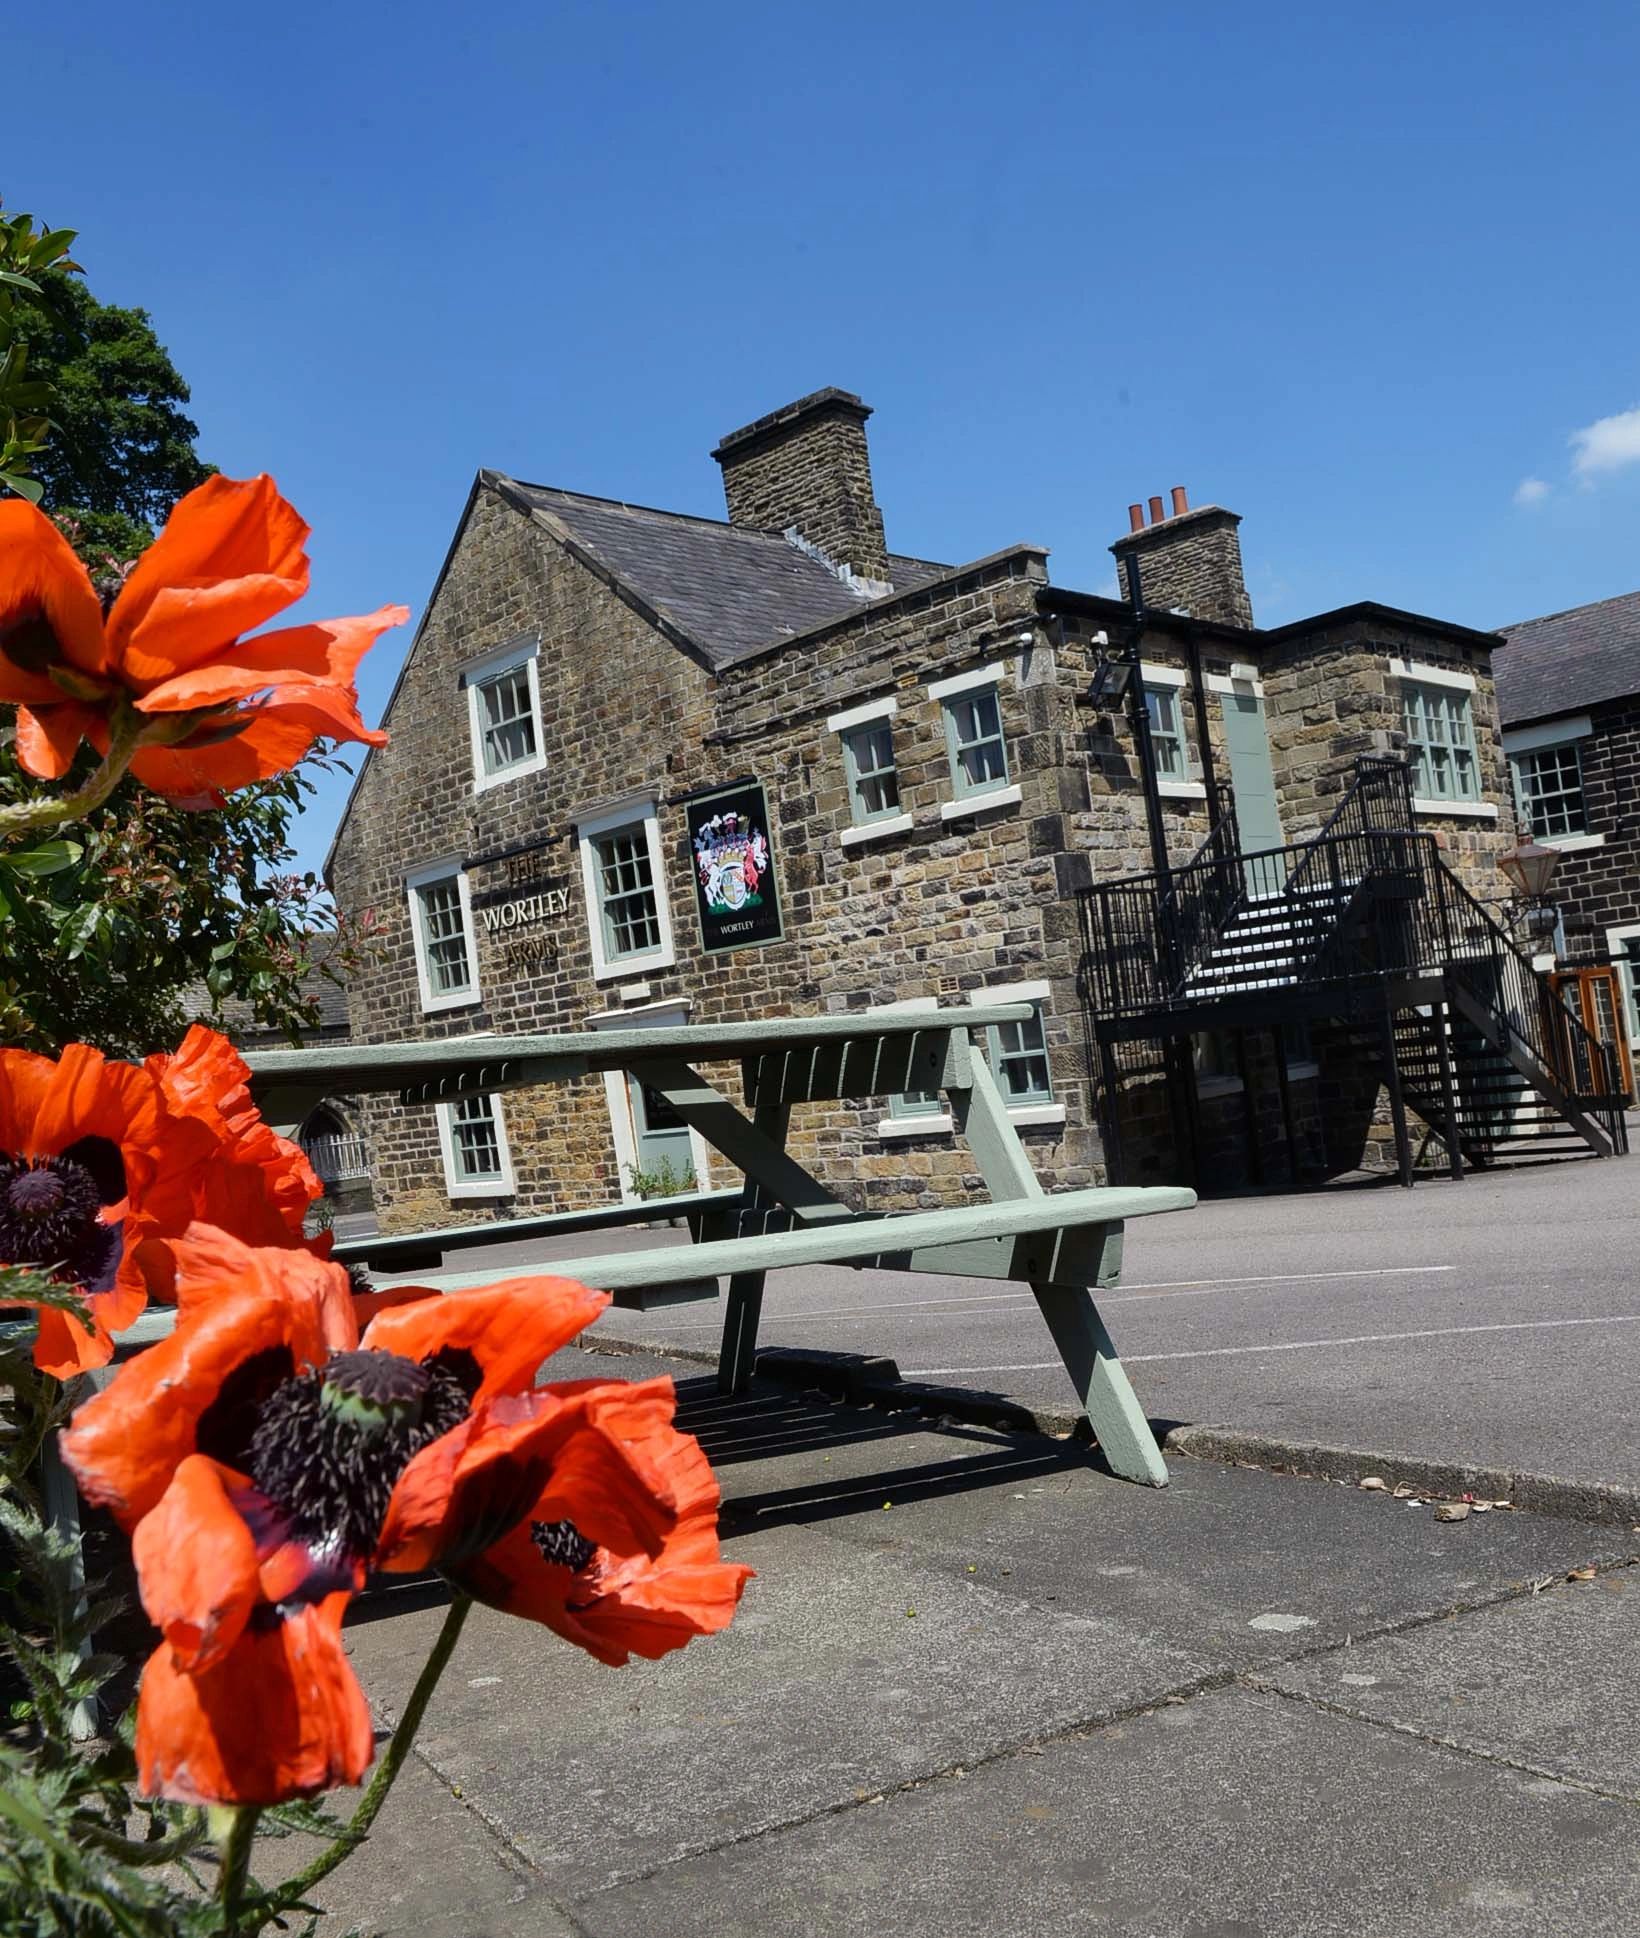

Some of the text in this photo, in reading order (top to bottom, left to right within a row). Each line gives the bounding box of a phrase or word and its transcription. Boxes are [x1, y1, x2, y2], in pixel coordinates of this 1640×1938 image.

[482, 887, 570, 931] WORTLEY
[720, 920, 754, 935] WORTLEY
[509, 935, 558, 965] ARMS
